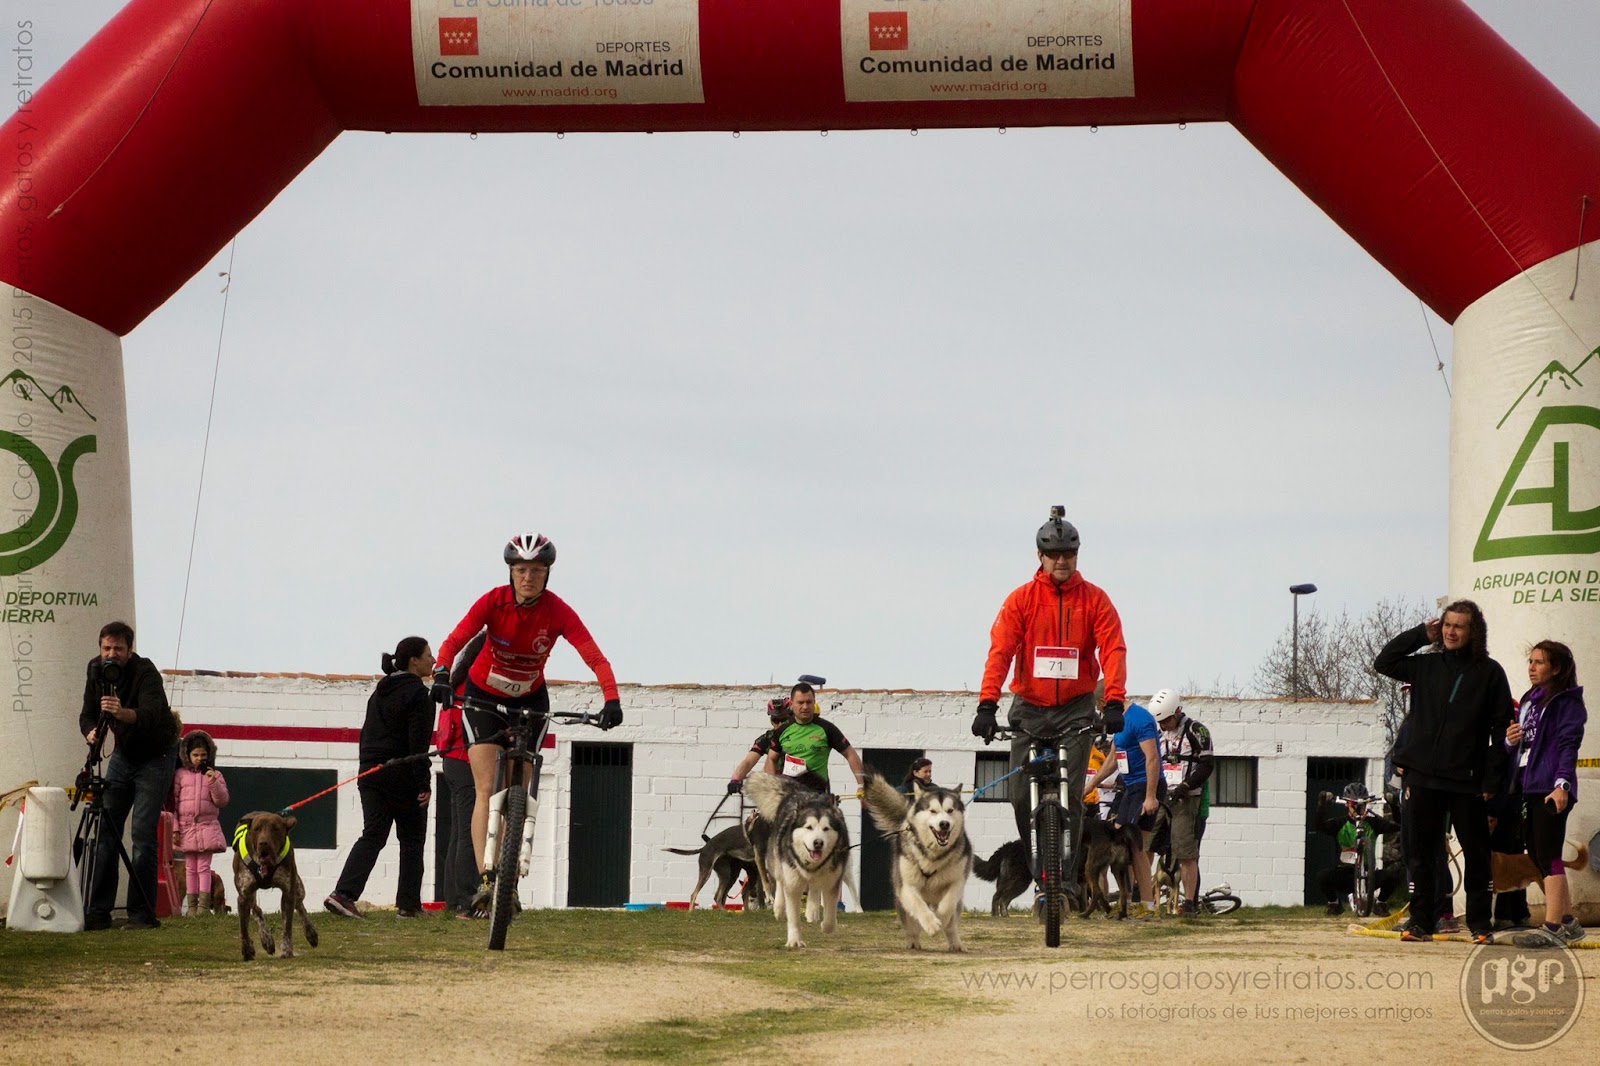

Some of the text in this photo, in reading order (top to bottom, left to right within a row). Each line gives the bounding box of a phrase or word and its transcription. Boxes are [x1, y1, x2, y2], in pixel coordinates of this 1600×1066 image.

[596, 41, 671, 53] DEPORTES
[1027, 35, 1103, 48] DEPORTES
[431, 59, 684, 79] Comunidad de Madrid
[859, 53, 1116, 74] Comunidad de Madrid
[502, 86, 618, 98] www.madrid.org
[930, 81, 1048, 93] www.madrid.org
[1473, 570, 1581, 592] AGRUPACION
[6, 592, 98, 607] DEPORTIVA
[1513, 588, 1600, 604] DE LA SIE
[0, 609, 55, 623] IERRA
[1049, 661, 1063, 671] 71
[504, 681, 521, 693] 70
